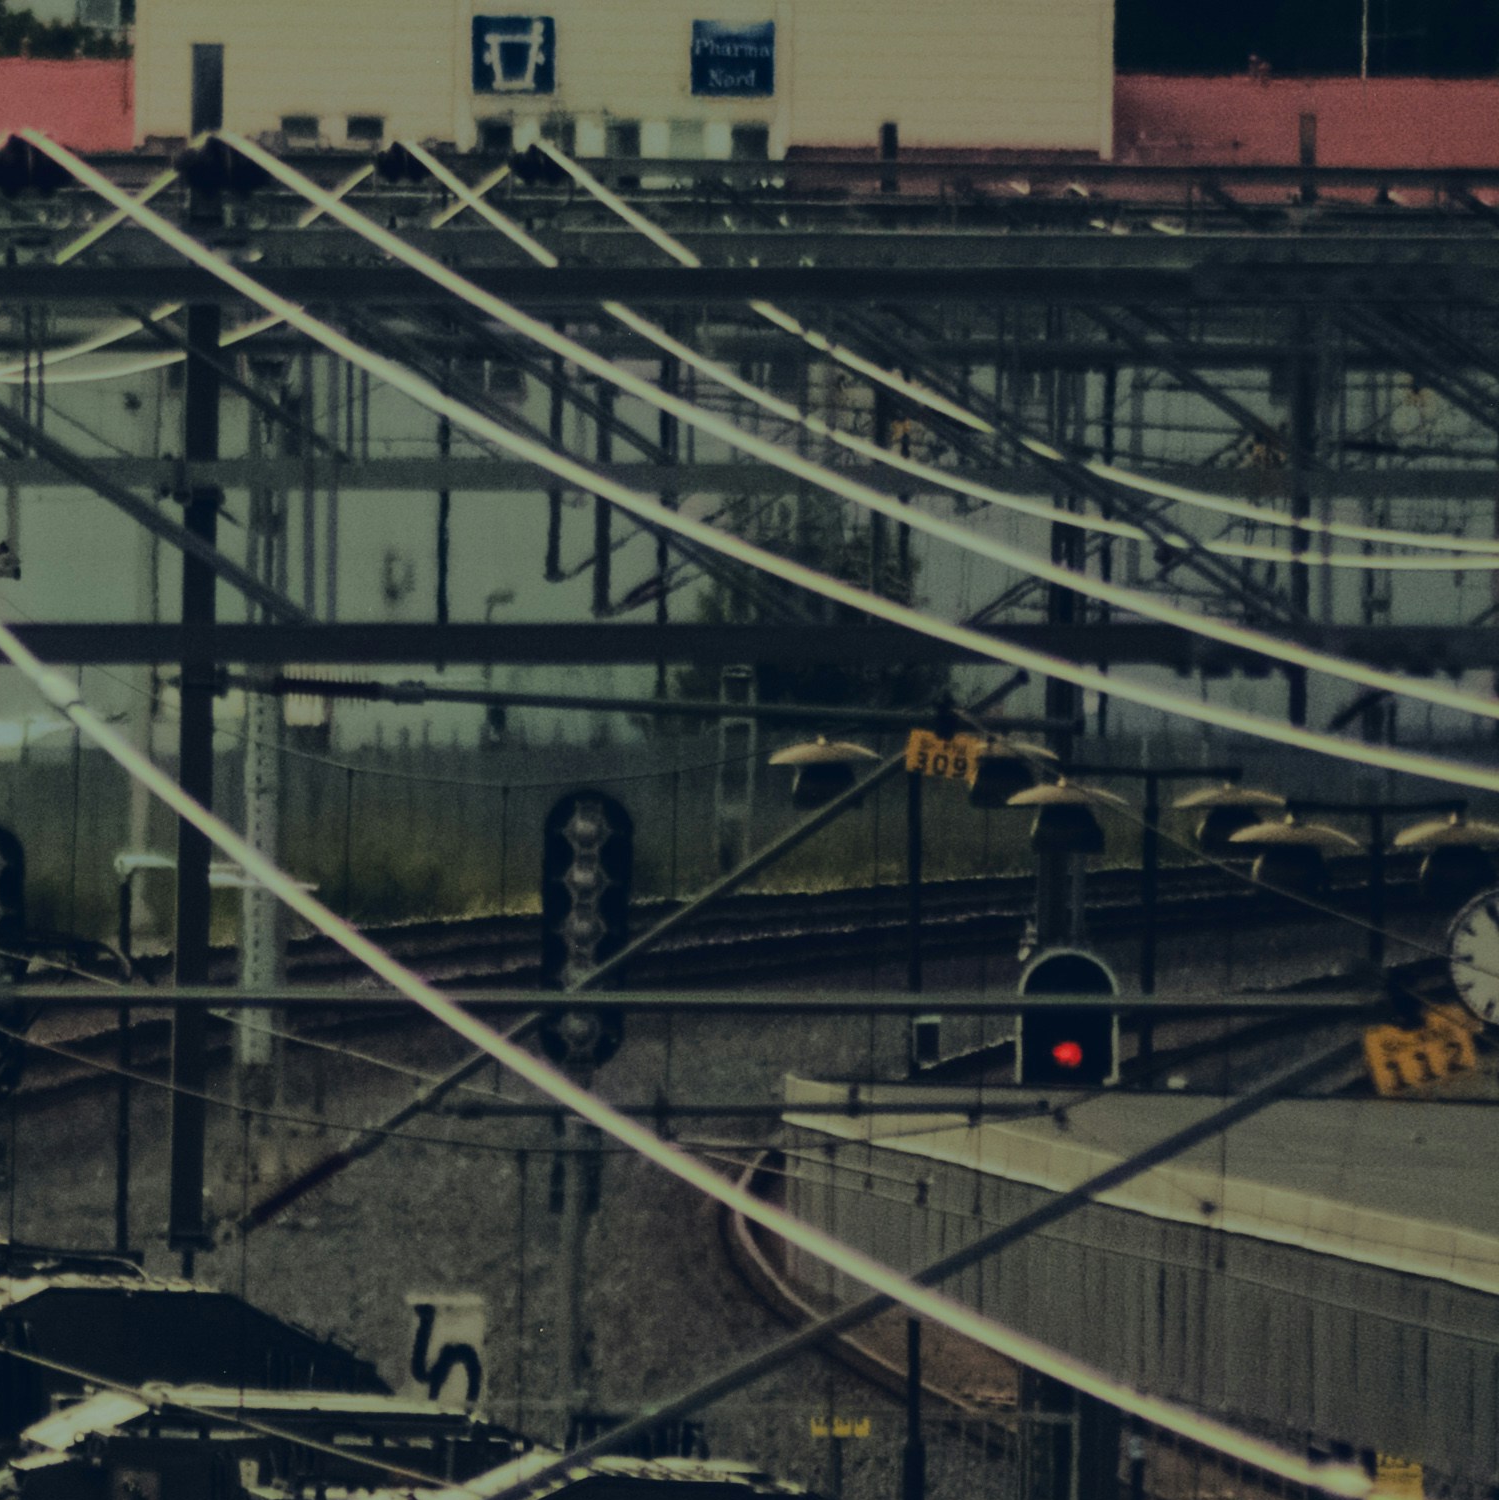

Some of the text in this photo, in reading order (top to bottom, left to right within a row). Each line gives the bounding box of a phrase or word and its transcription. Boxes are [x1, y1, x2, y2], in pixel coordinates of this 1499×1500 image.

[694, 38, 770, 58] Pharma
[709, 69, 756, 88] Nord
[914, 752, 968, 778] 309
[1385, 1041, 1466, 1089] 112
